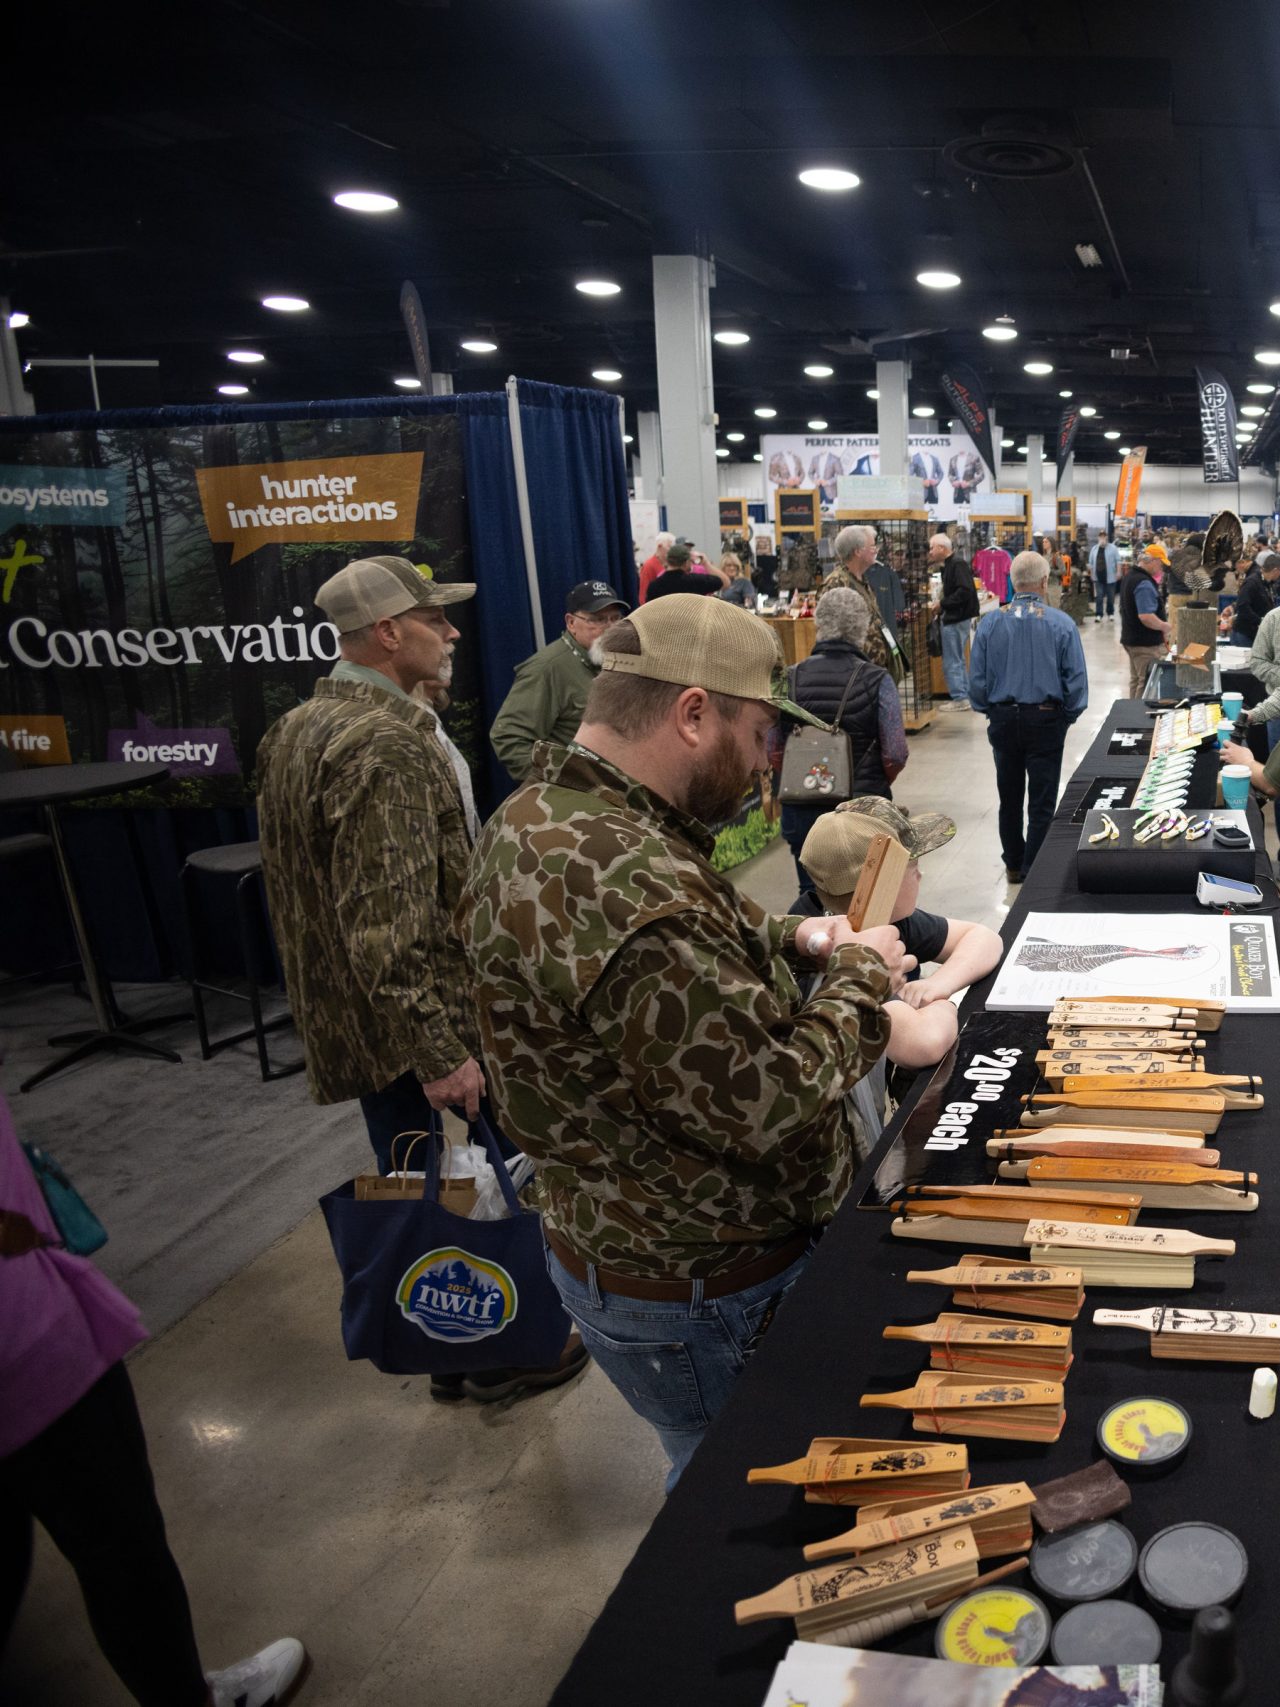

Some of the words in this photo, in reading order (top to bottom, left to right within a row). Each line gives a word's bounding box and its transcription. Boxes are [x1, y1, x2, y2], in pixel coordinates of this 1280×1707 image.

[1218, 407, 1227, 419] DO
[805, 437, 843, 447] PERFECT
[849, 437, 879, 447] PATTER
[909, 437, 951, 447] RTCOATS
[1200, 407, 1220, 482] HUNTER
[260, 474, 357, 500] hunter
[226, 496, 397, 529] interactions
[8, 606, 342, 669] Conservatio
[11, 730, 51, 751] fire
[121, 740, 219, 766] forestry
[1248, 964, 1266, 980] BOY
[963, 1047, 1023, 1101] $20.00
[923, 1101, 979, 1151] each
[416, 1284, 500, 1319] nwtf
[447, 1283, 472, 1294] 2025
[415, 1303, 451, 1318] CONVENTION
[924, 1542, 940, 1569] BOX
